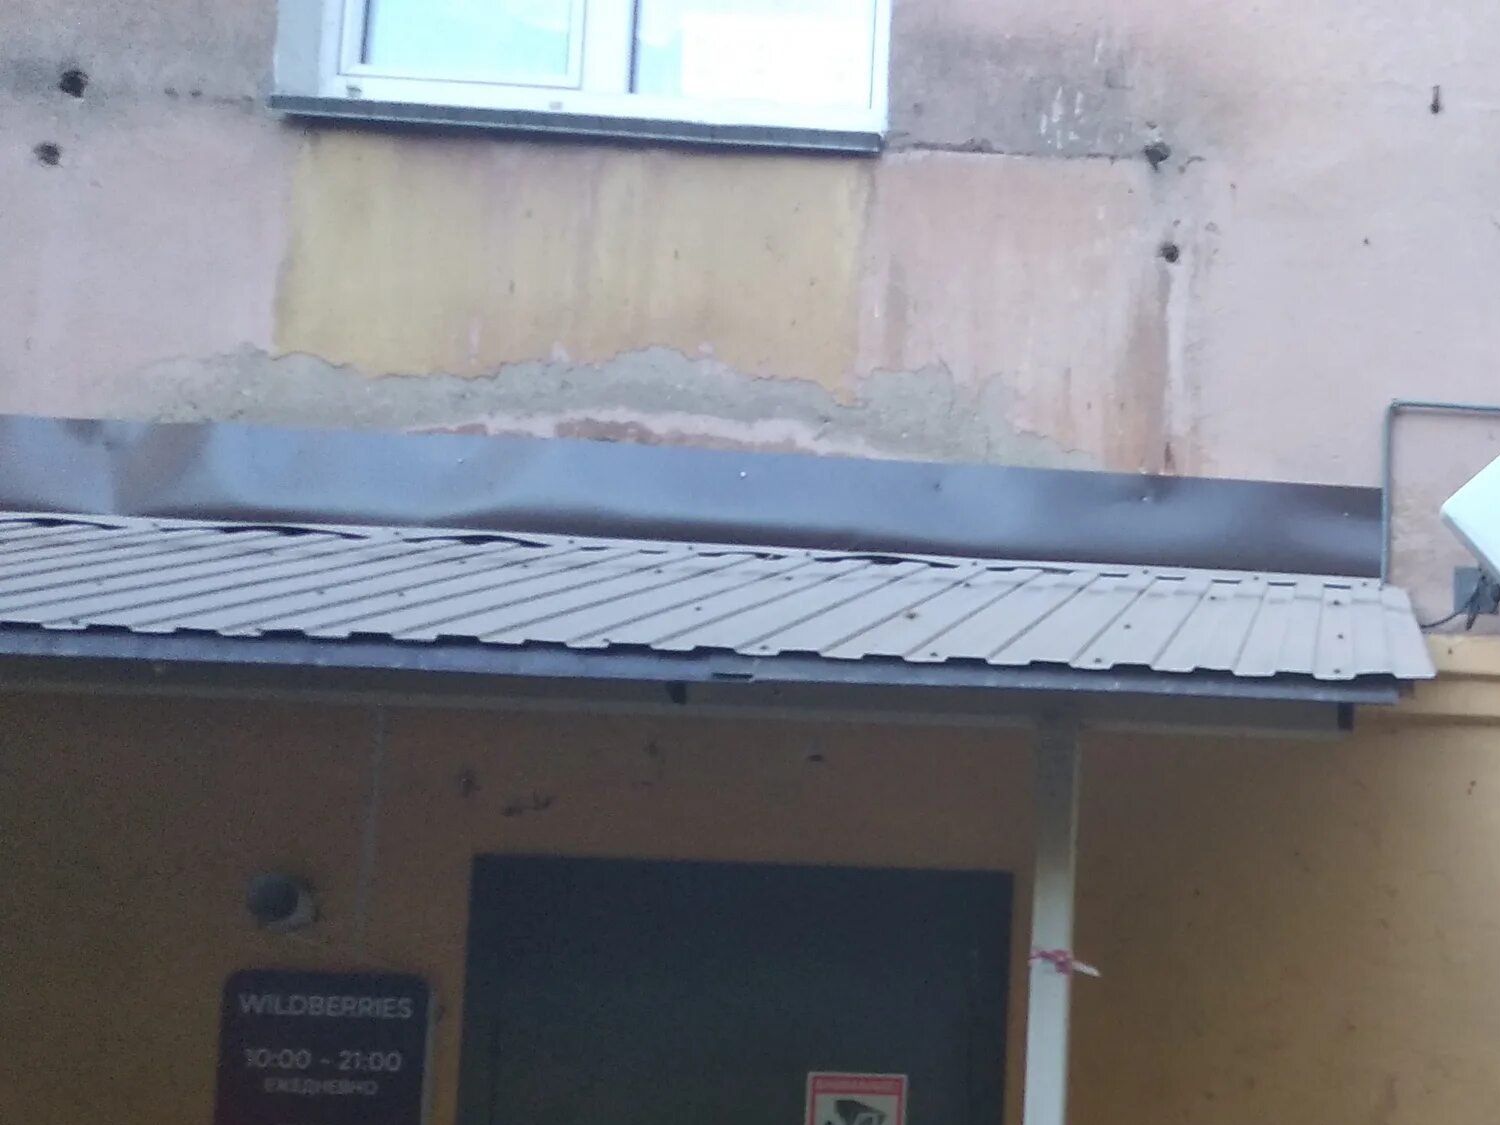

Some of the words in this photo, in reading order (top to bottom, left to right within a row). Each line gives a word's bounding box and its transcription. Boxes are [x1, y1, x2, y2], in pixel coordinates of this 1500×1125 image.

[238, 993, 415, 1019] WILDBERRIES
[245, 1048, 312, 1070] 10:00
[338, 1049, 403, 1072] 21:00
